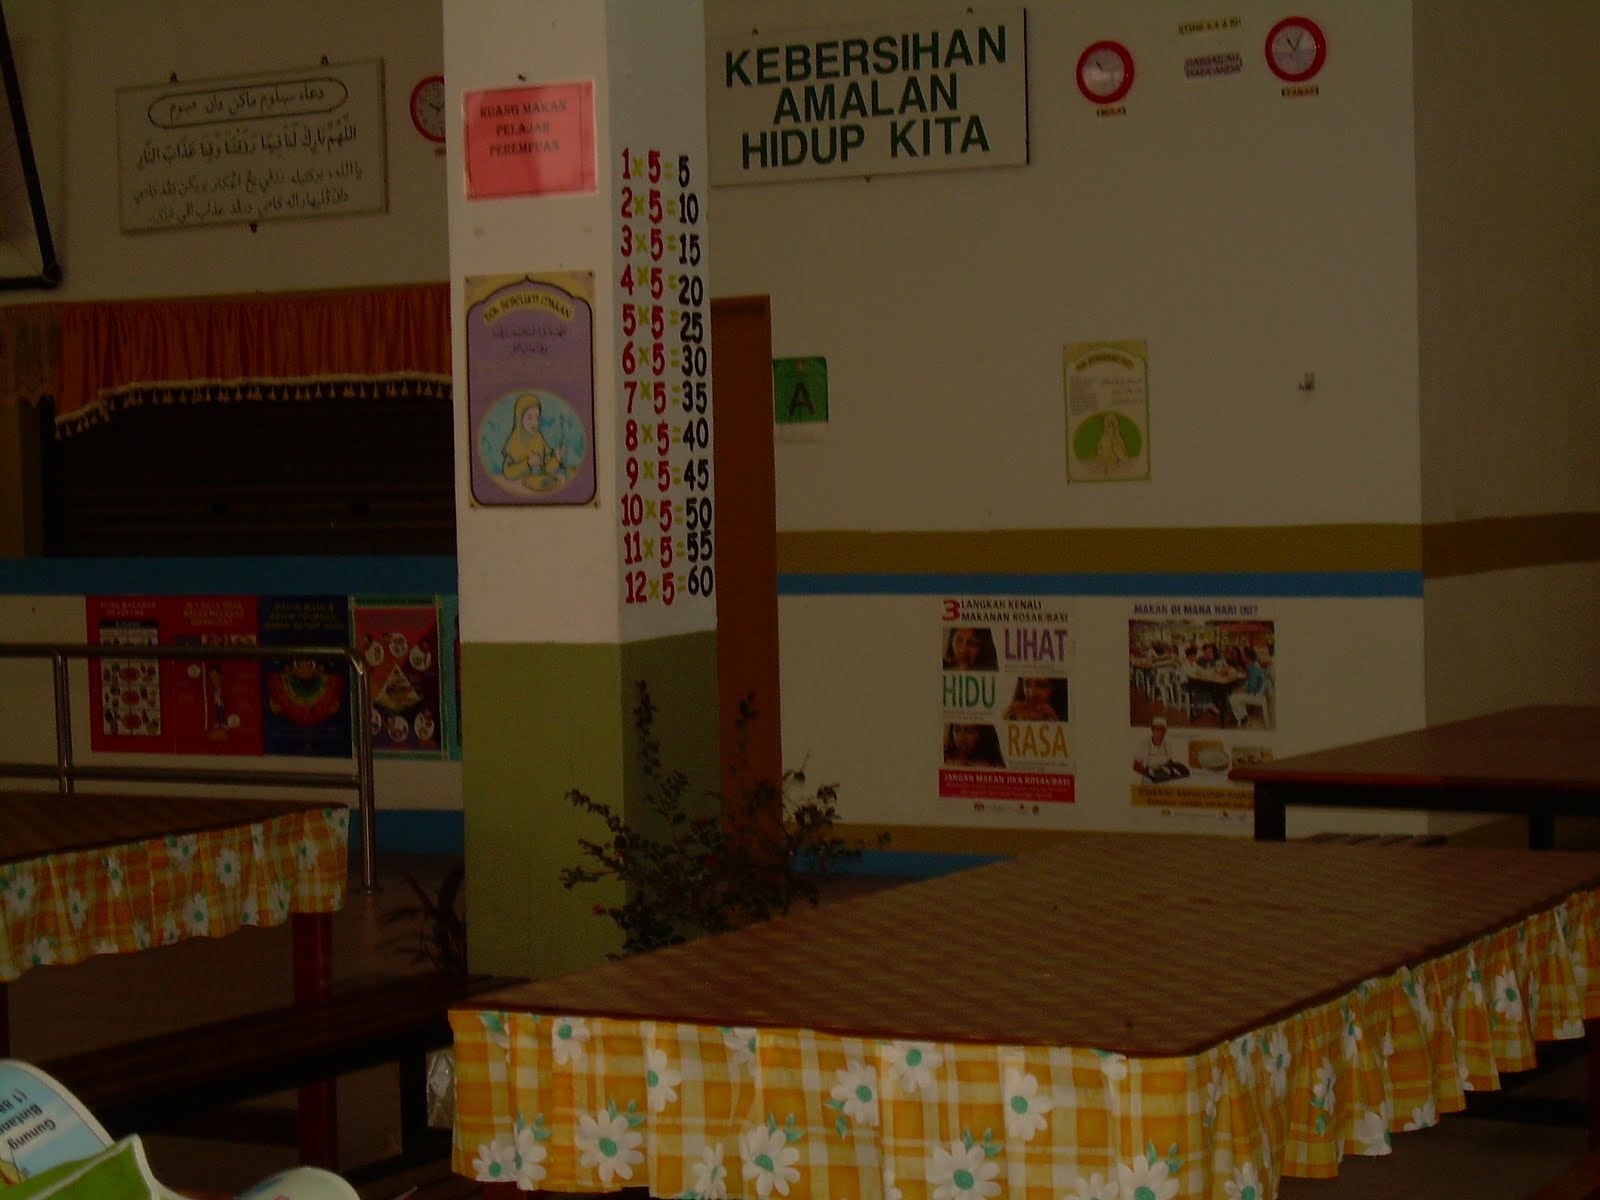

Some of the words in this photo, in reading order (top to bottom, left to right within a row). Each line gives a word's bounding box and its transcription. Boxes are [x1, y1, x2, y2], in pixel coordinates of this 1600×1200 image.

[724, 24, 1007, 88] KEBERSIHAN
[480, 103, 519, 118] RUANG
[523, 100, 567, 113] MAKAN
[773, 72, 959, 124] AMALAN
[496, 122, 550, 136] PELAJAR
[742, 124, 866, 169] HIDUP
[890, 114, 990, 158] KITA
[489, 140, 560, 156] PEREMPUAN
[678, 155, 690, 187] 5
[679, 193, 699, 225] 10
[679, 233, 701, 266] 15
[678, 275, 703, 307] 20
[680, 312, 703, 344] 25
[681, 344, 707, 377] 30
[682, 380, 708, 414] 35
[788, 382, 816, 416] A
[682, 417, 709, 451] 40
[683, 459, 709, 491] 45
[685, 497, 712, 530] 50
[687, 530, 713, 563] 55
[687, 565, 714, 597] 60
[942, 599, 960, 621] 3
[961, 599, 1006, 610] LANGKAH
[1008, 599, 1042, 610] KENALI
[961, 612, 1010, 622] MAKANAN
[1134, 603, 1168, 615] MAKAN
[1171, 603, 1181, 614] DI
[1183, 604, 1212, 615] MANA
[1214, 604, 1237, 615] HARI
[1004, 628, 1068, 661] LIHAT
[942, 675, 996, 708] HIDU
[1007, 723, 1069, 758] RASA
[944, 772, 974, 784] JANGAN
[975, 773, 1006, 784] MAKAN
[7, 1119, 56, 1150] Gunung
